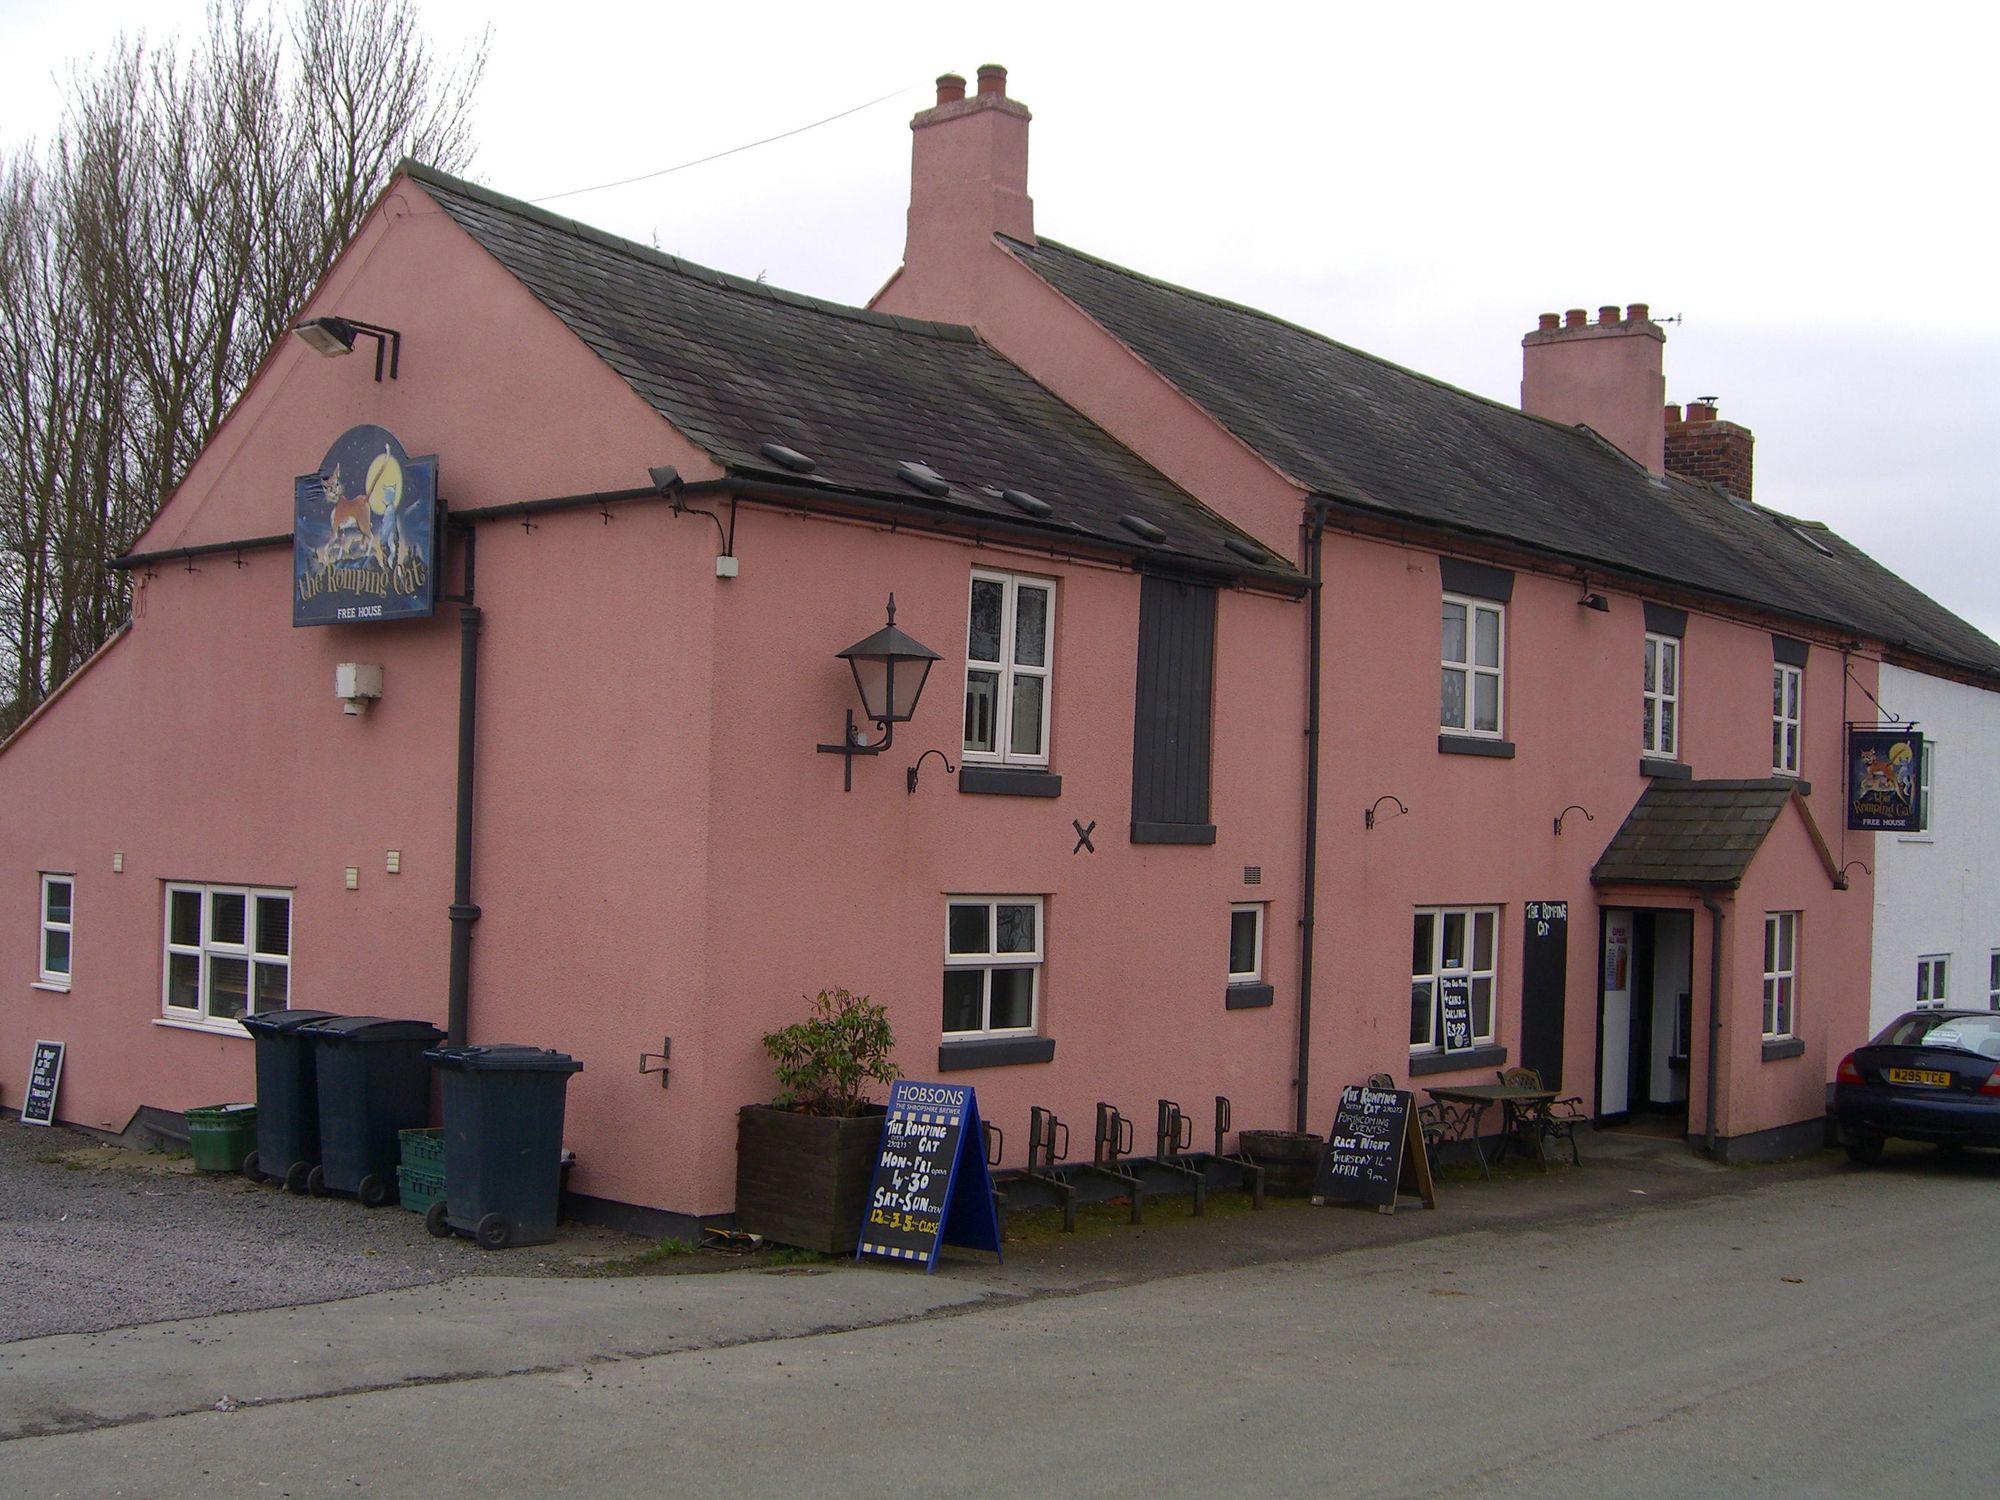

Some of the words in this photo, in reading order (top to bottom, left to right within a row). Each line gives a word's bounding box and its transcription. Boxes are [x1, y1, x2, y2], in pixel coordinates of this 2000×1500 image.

[326, 565, 389, 597] Romping
[393, 561, 426, 595] Cat
[337, 607, 356, 619] FREE
[358, 605, 383, 617] HOUSE
[1862, 818, 1881, 826] FREE
[1925, 1072, 1946, 1083] TCE
[897, 1085, 964, 1105] HOBSONS
[1360, 1087, 1398, 1106] ROMPING
[906, 1104, 938, 1113] SHROPSHIRE
[939, 1106, 961, 1115] BREWER
[1363, 1103, 1382, 1115] CAT
[887, 1119, 903, 1136] THE
[905, 1120, 947, 1139] ROMPING
[918, 1137, 940, 1153] CAT
[1333, 1136, 1356, 1149] RACE
[1360, 1137, 1391, 1151] NIGHT
[1330, 1149, 1374, 1166] THURSDAY
[1332, 1163, 1360, 1178] APRIL
